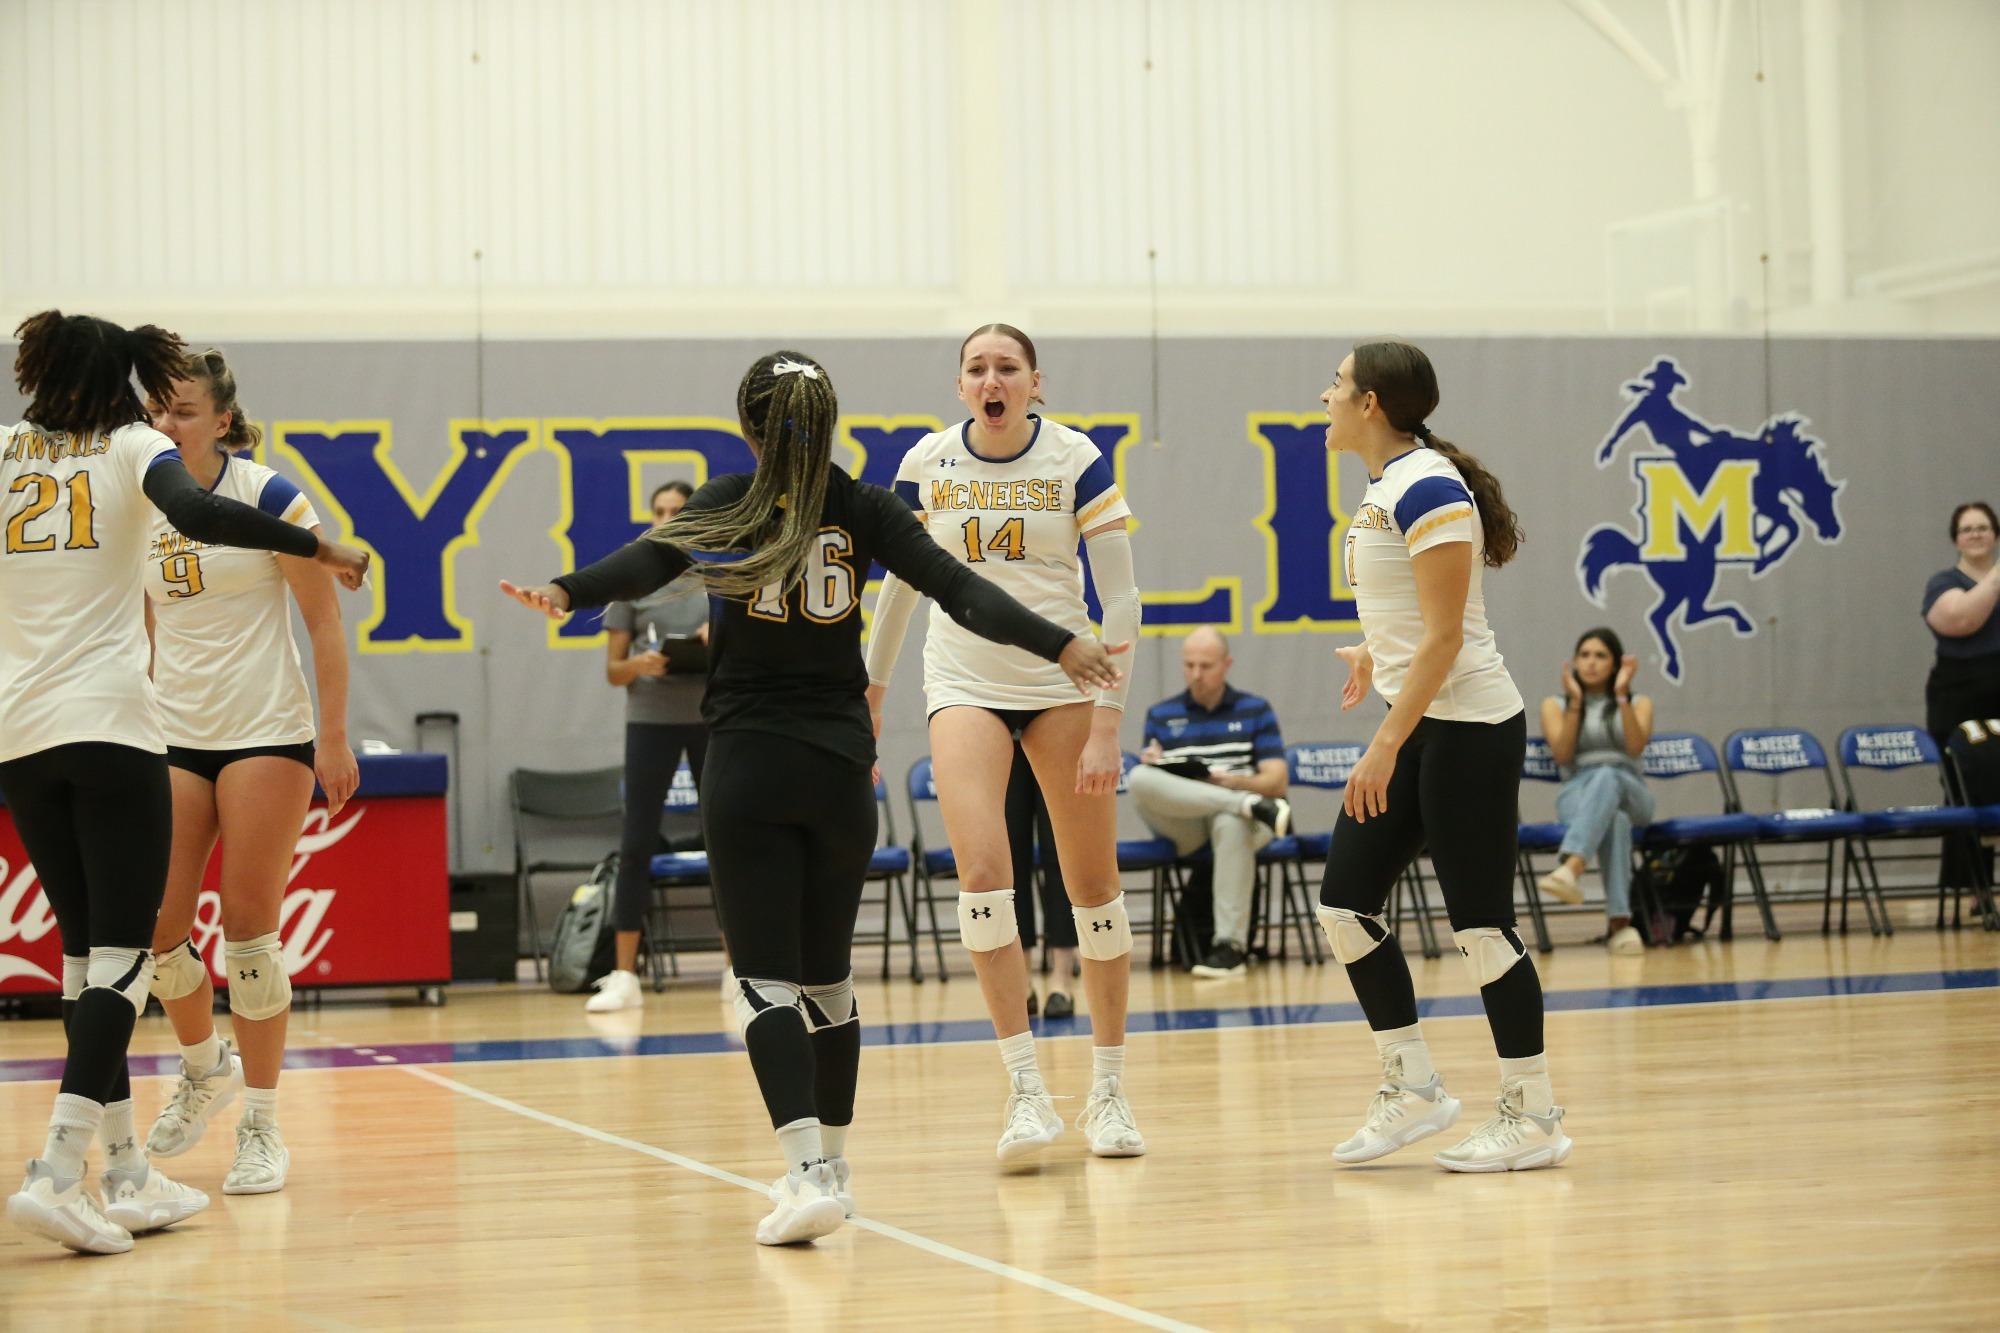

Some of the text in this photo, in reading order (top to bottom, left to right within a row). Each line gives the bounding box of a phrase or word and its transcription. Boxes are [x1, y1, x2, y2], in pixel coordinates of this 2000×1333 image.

[6, 470, 99, 554] 21
[961, 517, 1025, 563] 14
[1640, 459, 1761, 562] M
[160, 552, 205, 597] 9
